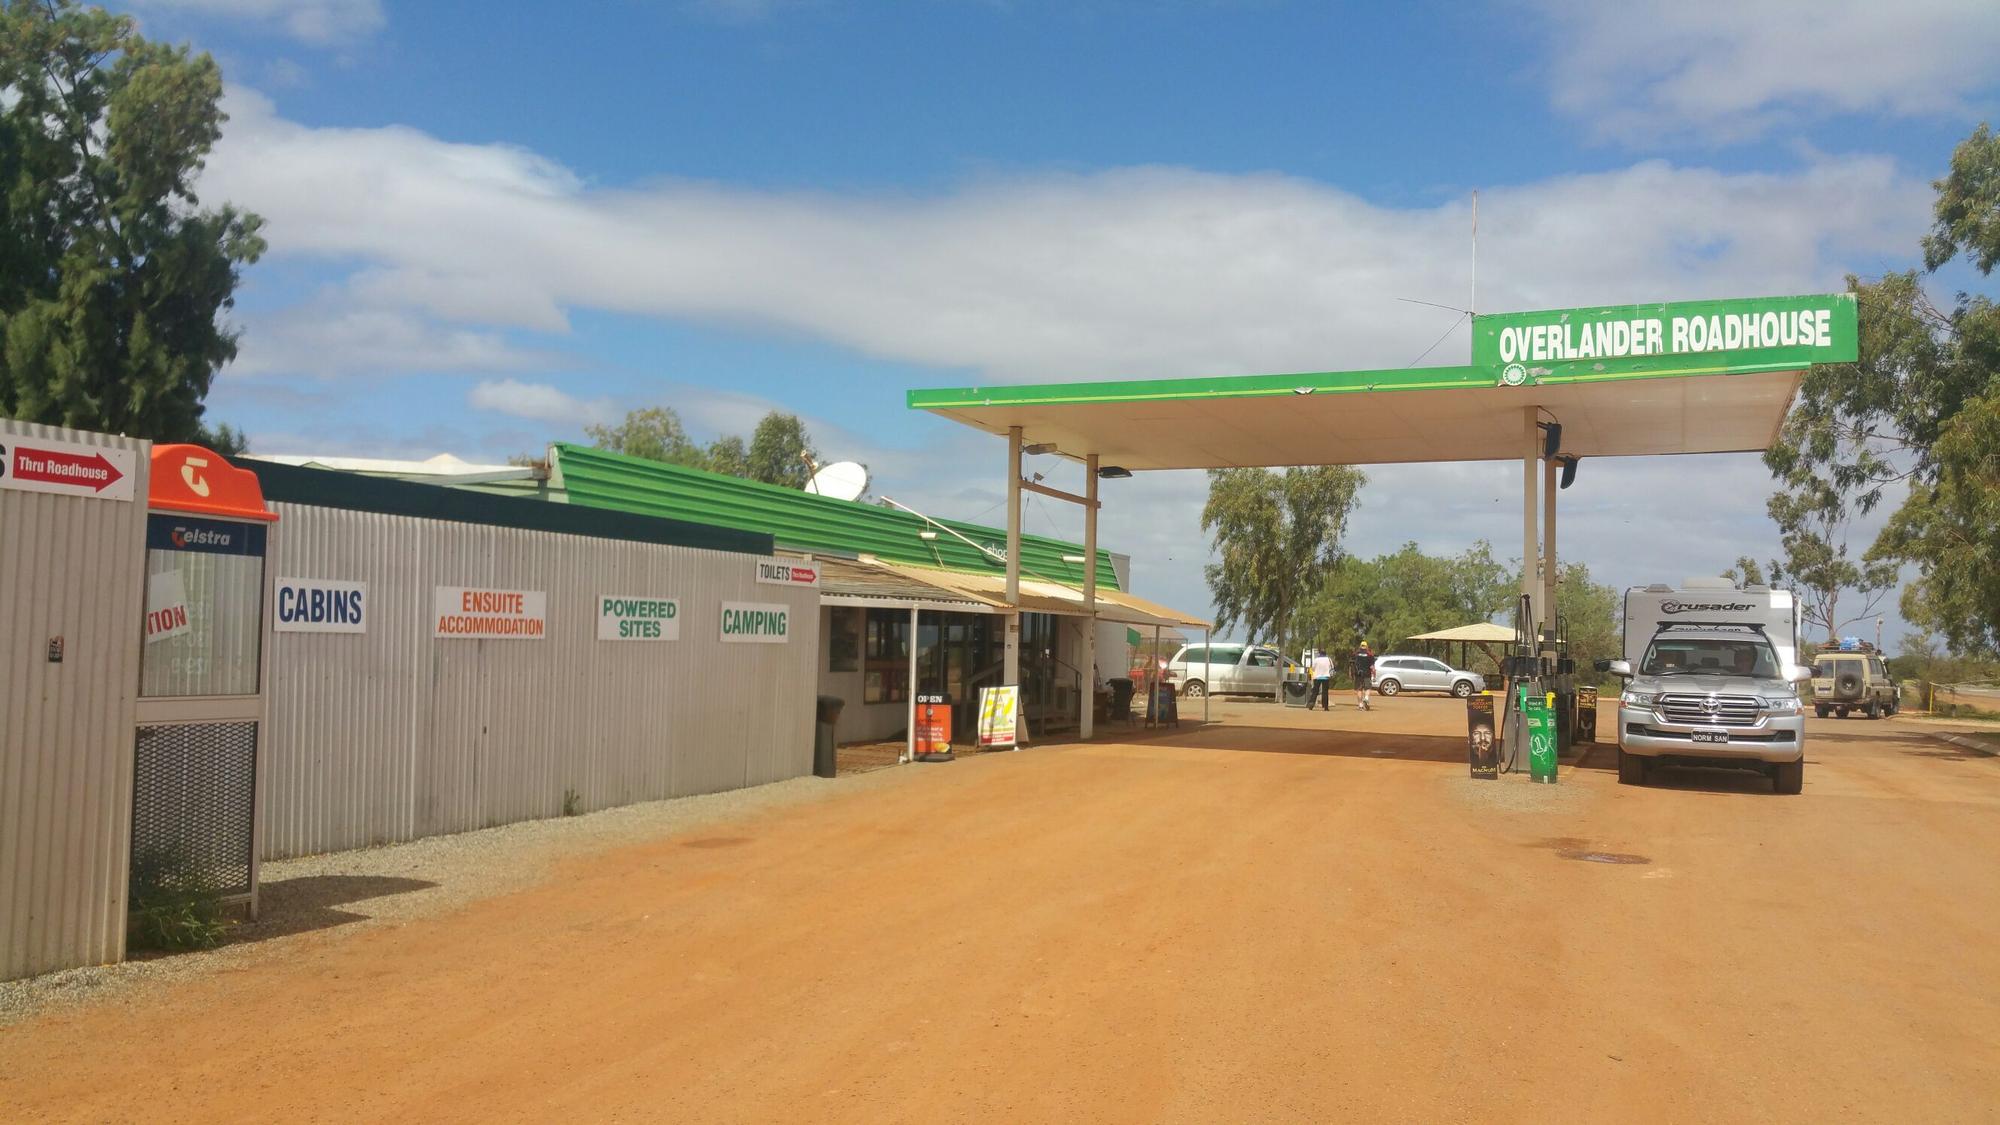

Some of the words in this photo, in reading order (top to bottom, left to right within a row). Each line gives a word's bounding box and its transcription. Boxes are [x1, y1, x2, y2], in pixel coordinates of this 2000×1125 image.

[1499, 318, 1663, 363] OVERLANDER
[1672, 309, 1831, 353] ROADHOUSE
[19, 456, 44, 473] Thru
[47, 460, 108, 480] Roadhouse
[171, 526, 230, 547] Telstra
[760, 564, 790, 581] TOILETS
[279, 586, 362, 625] CABINS
[462, 591, 524, 614] ENSUITE
[603, 599, 677, 618] POWERED
[438, 616, 544, 635] ACCOMMODATION
[619, 620, 661, 638] SITES
[723, 609, 786, 635] CAMPING
[917, 695, 943, 703] OPEN
